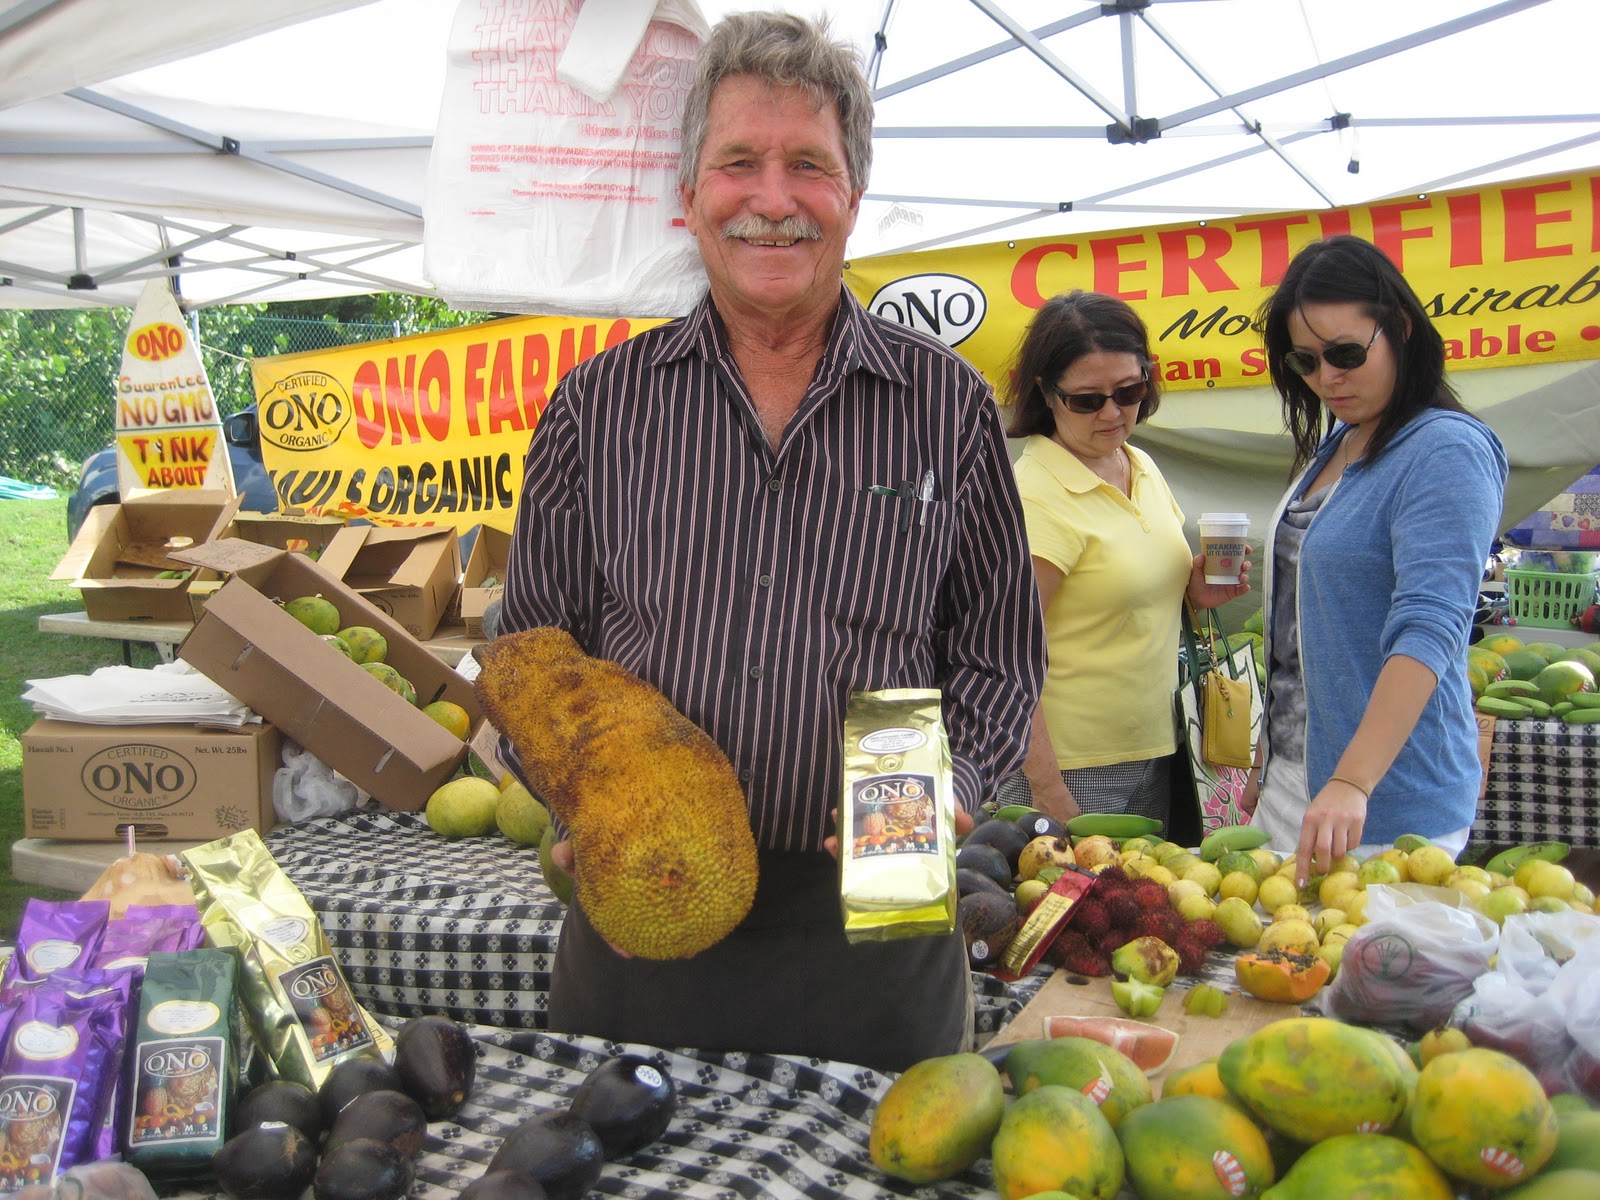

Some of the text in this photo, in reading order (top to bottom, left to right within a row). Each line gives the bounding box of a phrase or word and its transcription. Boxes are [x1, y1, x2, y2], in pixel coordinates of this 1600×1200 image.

[876, 288, 976, 336] ONO
[136, 325, 183, 361] ONO
[278, 375, 328, 393] CERTIFIED
[119, 390, 213, 428] NO GMO
[265, 391, 343, 432] ONO
[353, 349, 451, 450] ONO
[147, 465, 208, 488] ABOUT
[368, 453, 514, 516] ORGANIC
[107, 747, 169, 760] CERTIFIED
[92, 762, 185, 794] ONO
[862, 782, 922, 801] ONO
[294, 970, 336, 996] ONO
[147, 1052, 207, 1071] ONO
[0, 1091, 53, 1112] ONO
